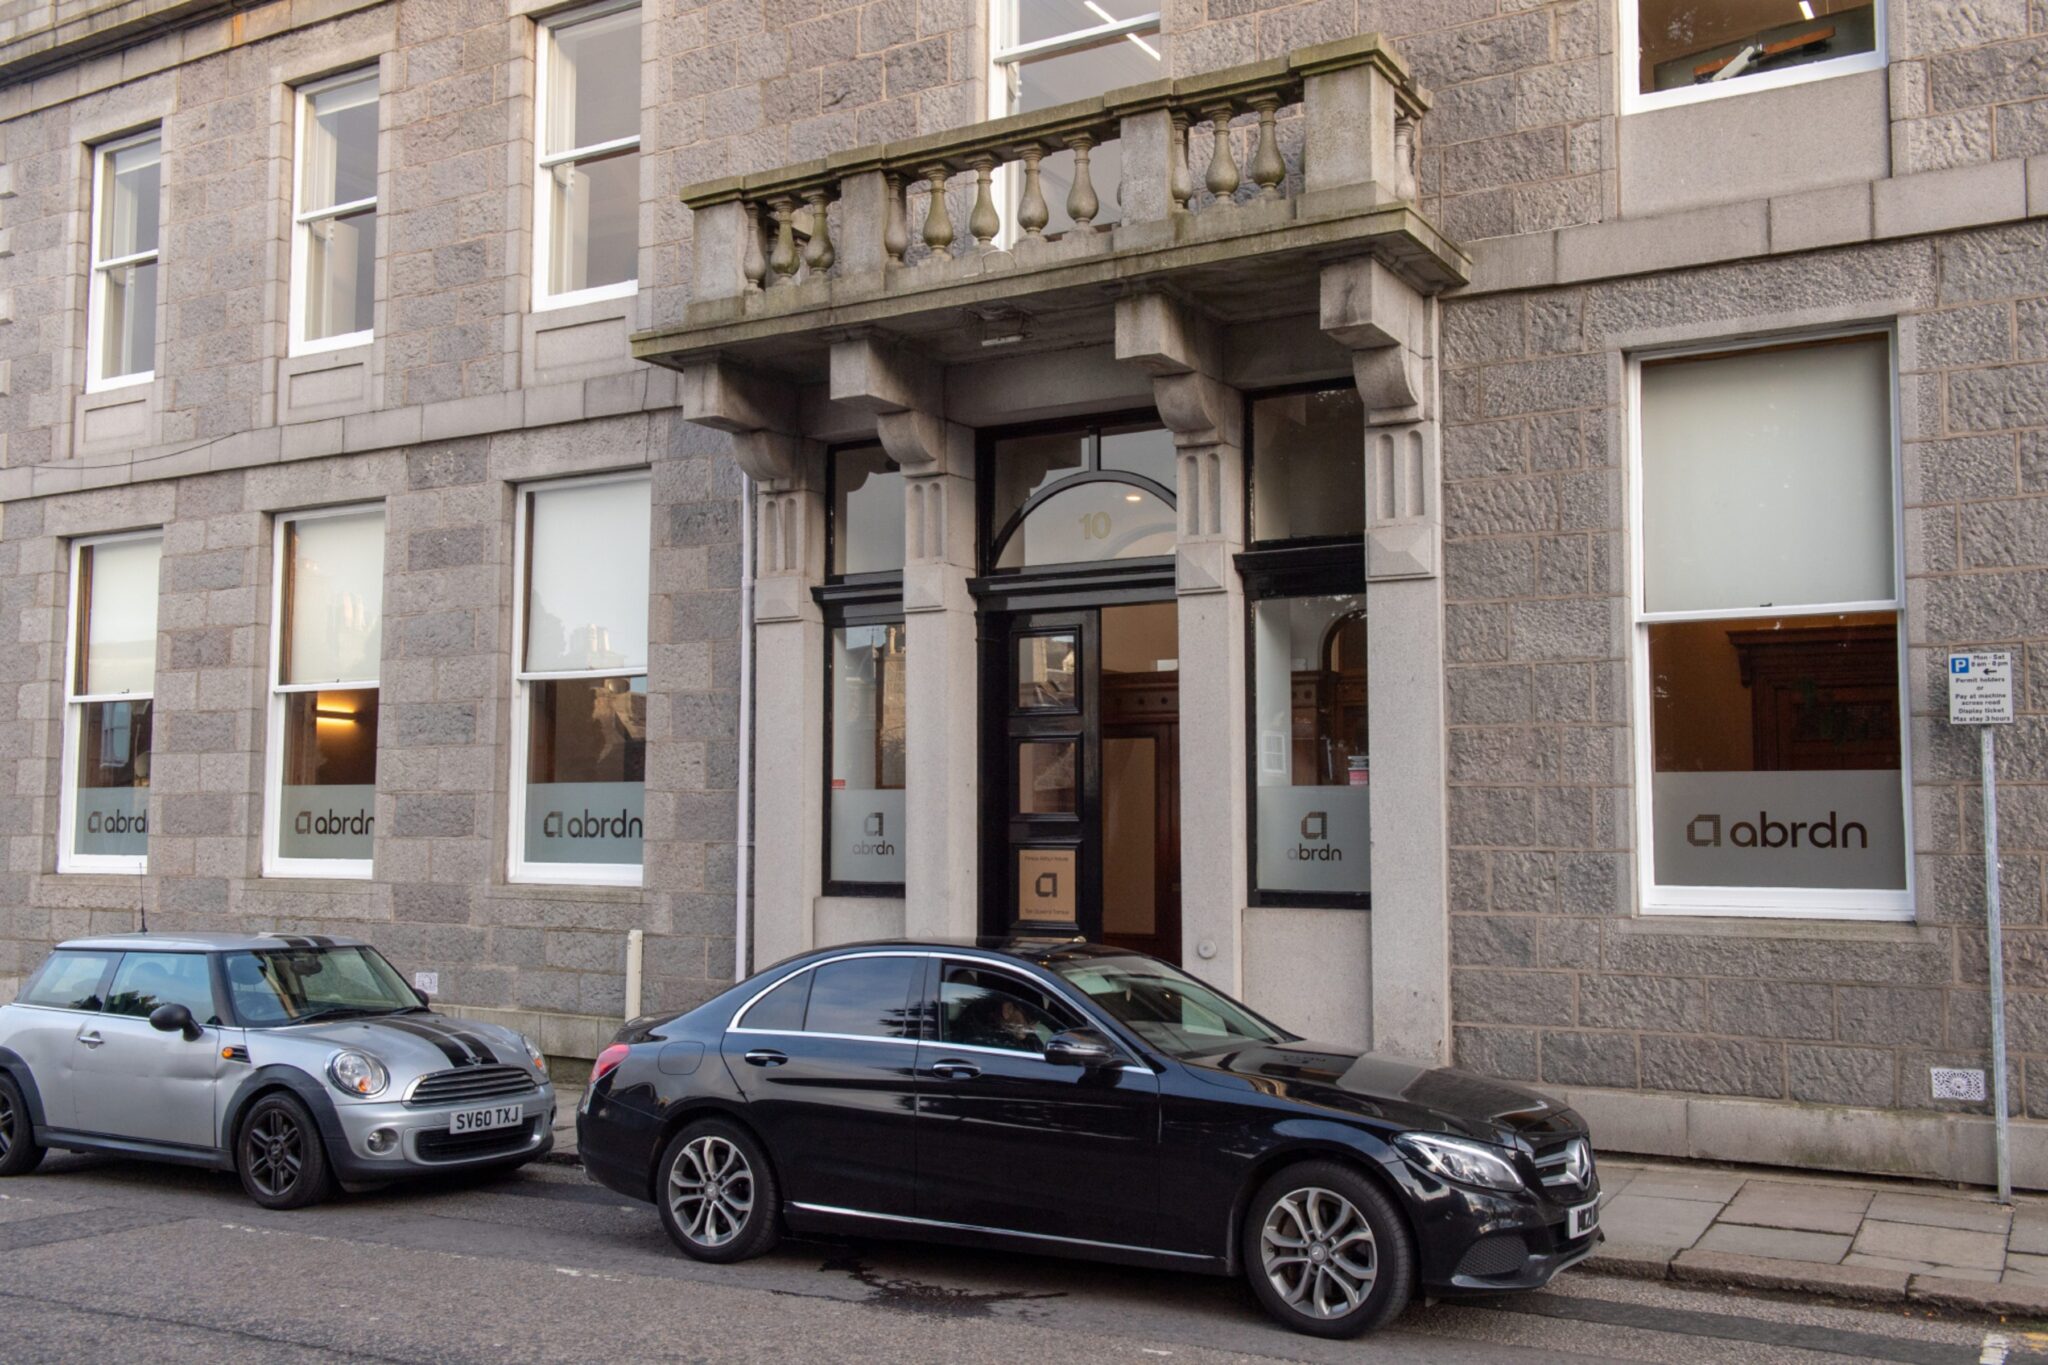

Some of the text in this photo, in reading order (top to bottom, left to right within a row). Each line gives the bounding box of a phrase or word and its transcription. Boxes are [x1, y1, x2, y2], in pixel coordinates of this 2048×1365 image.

[1079, 511, 1112, 540] 10
[104, 809, 149, 833] abrd
[567, 809, 643, 838] abrdn
[1730, 811, 1867, 848] abrdn
[852, 840, 894, 856] abrdn
[1287, 843, 1342, 861] abrdn
[456, 1107, 519, 1130] SV60 TXJ
